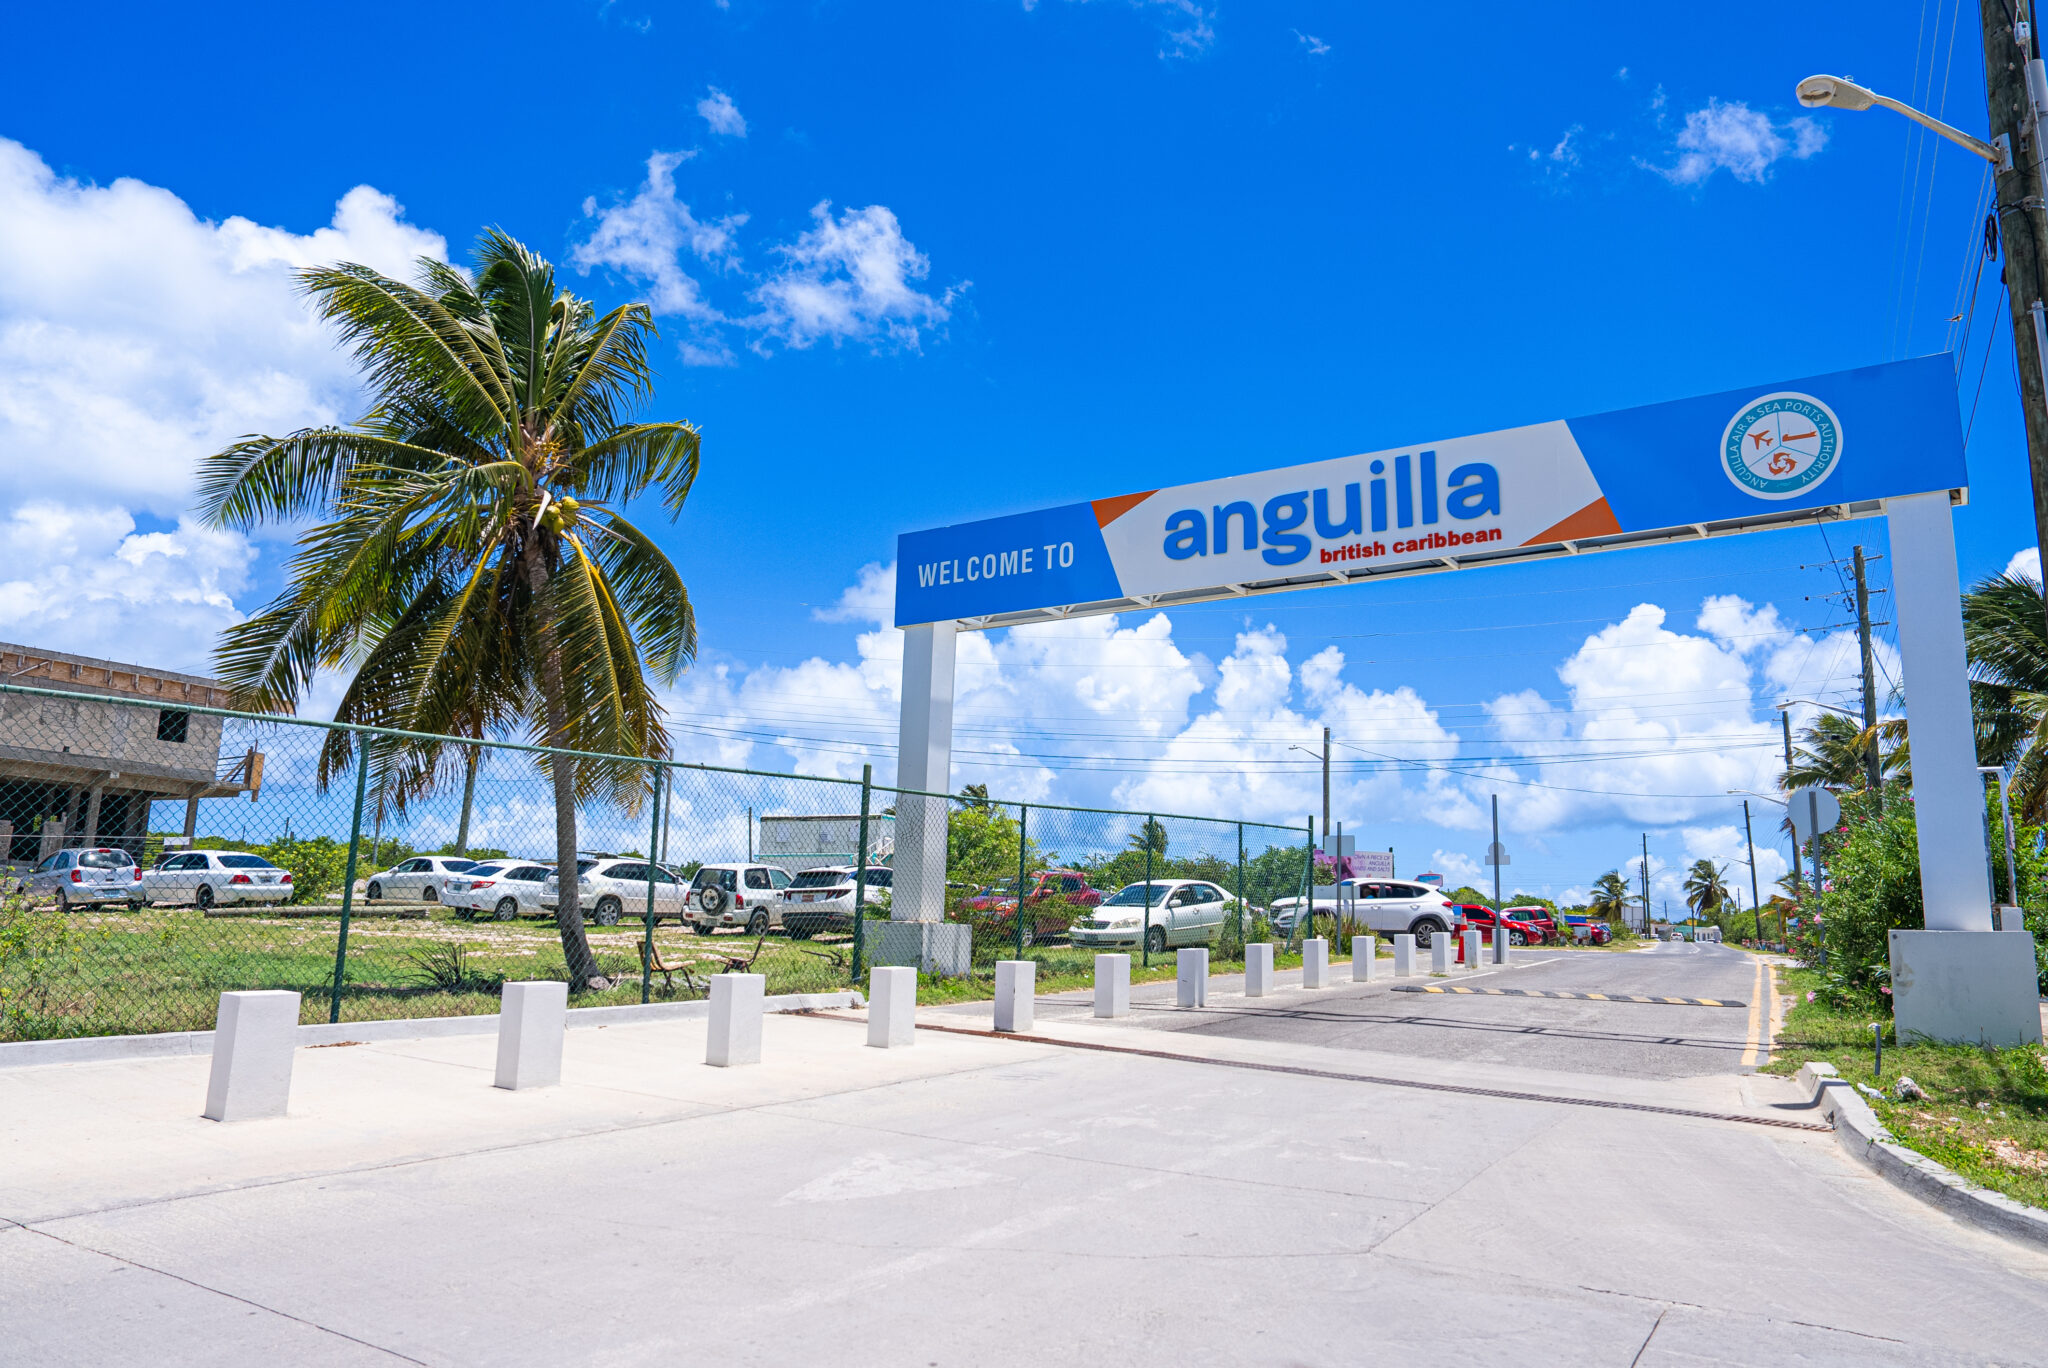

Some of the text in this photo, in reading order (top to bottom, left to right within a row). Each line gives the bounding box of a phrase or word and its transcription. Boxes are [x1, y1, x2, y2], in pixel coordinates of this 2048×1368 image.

[1729, 401, 1834, 489] ANGUILLA AIR & SEA PORTS AUTHORITY
[1163, 450, 1501, 567] anguilla
[918, 541, 1074, 588] WELCOME TO
[1320, 528, 1502, 564] british caribbean
